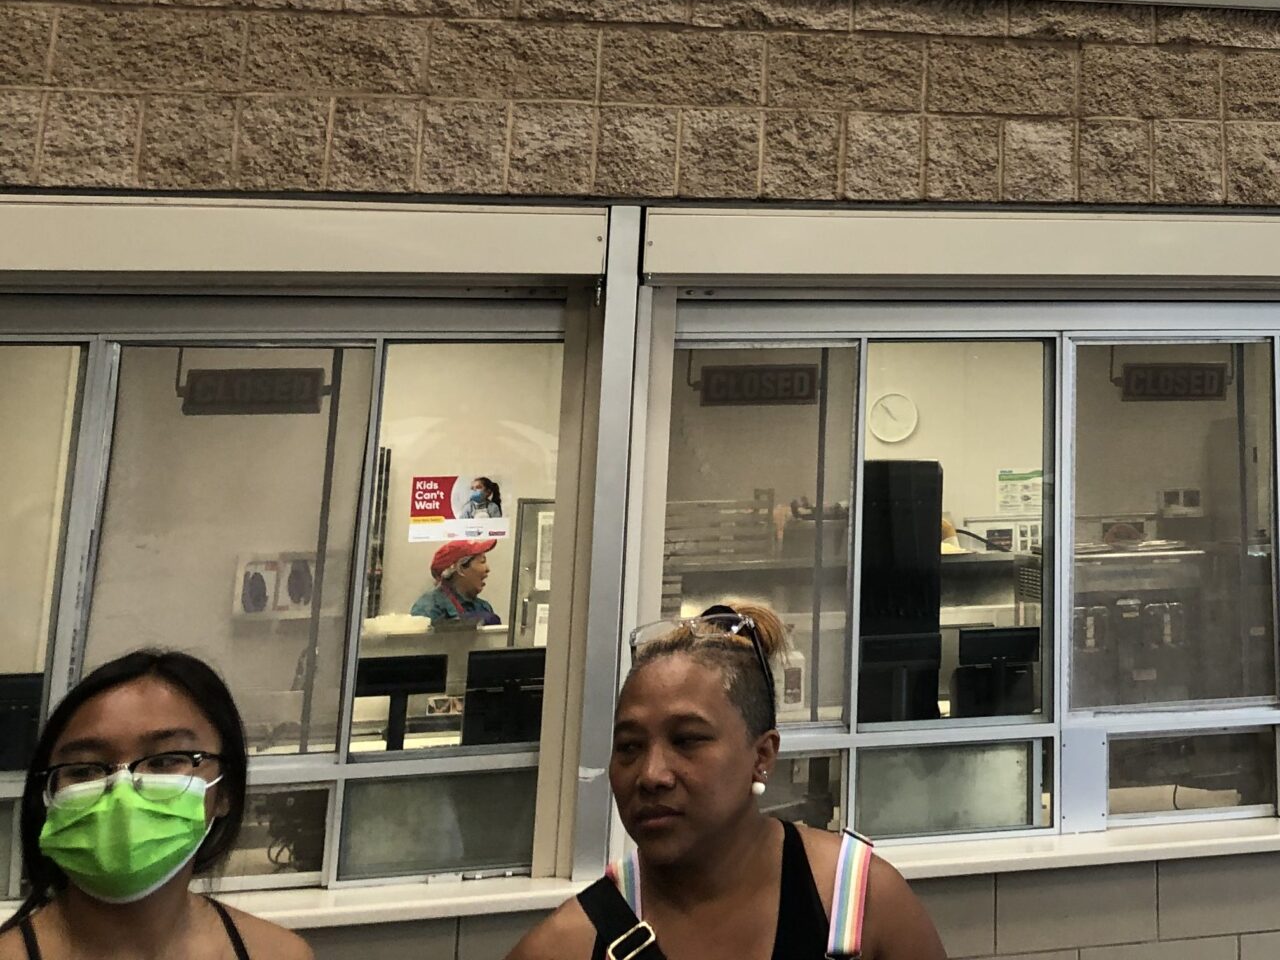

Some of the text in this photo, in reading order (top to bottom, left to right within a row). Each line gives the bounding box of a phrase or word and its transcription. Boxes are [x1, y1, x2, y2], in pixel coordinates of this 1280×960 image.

[710, 372, 810, 398] CLOSED
[1130, 369, 1218, 395] CLOSED
[416, 481, 438, 490] Kids
[415, 491, 444, 500] Can't
[415, 501, 440, 510] Wait
